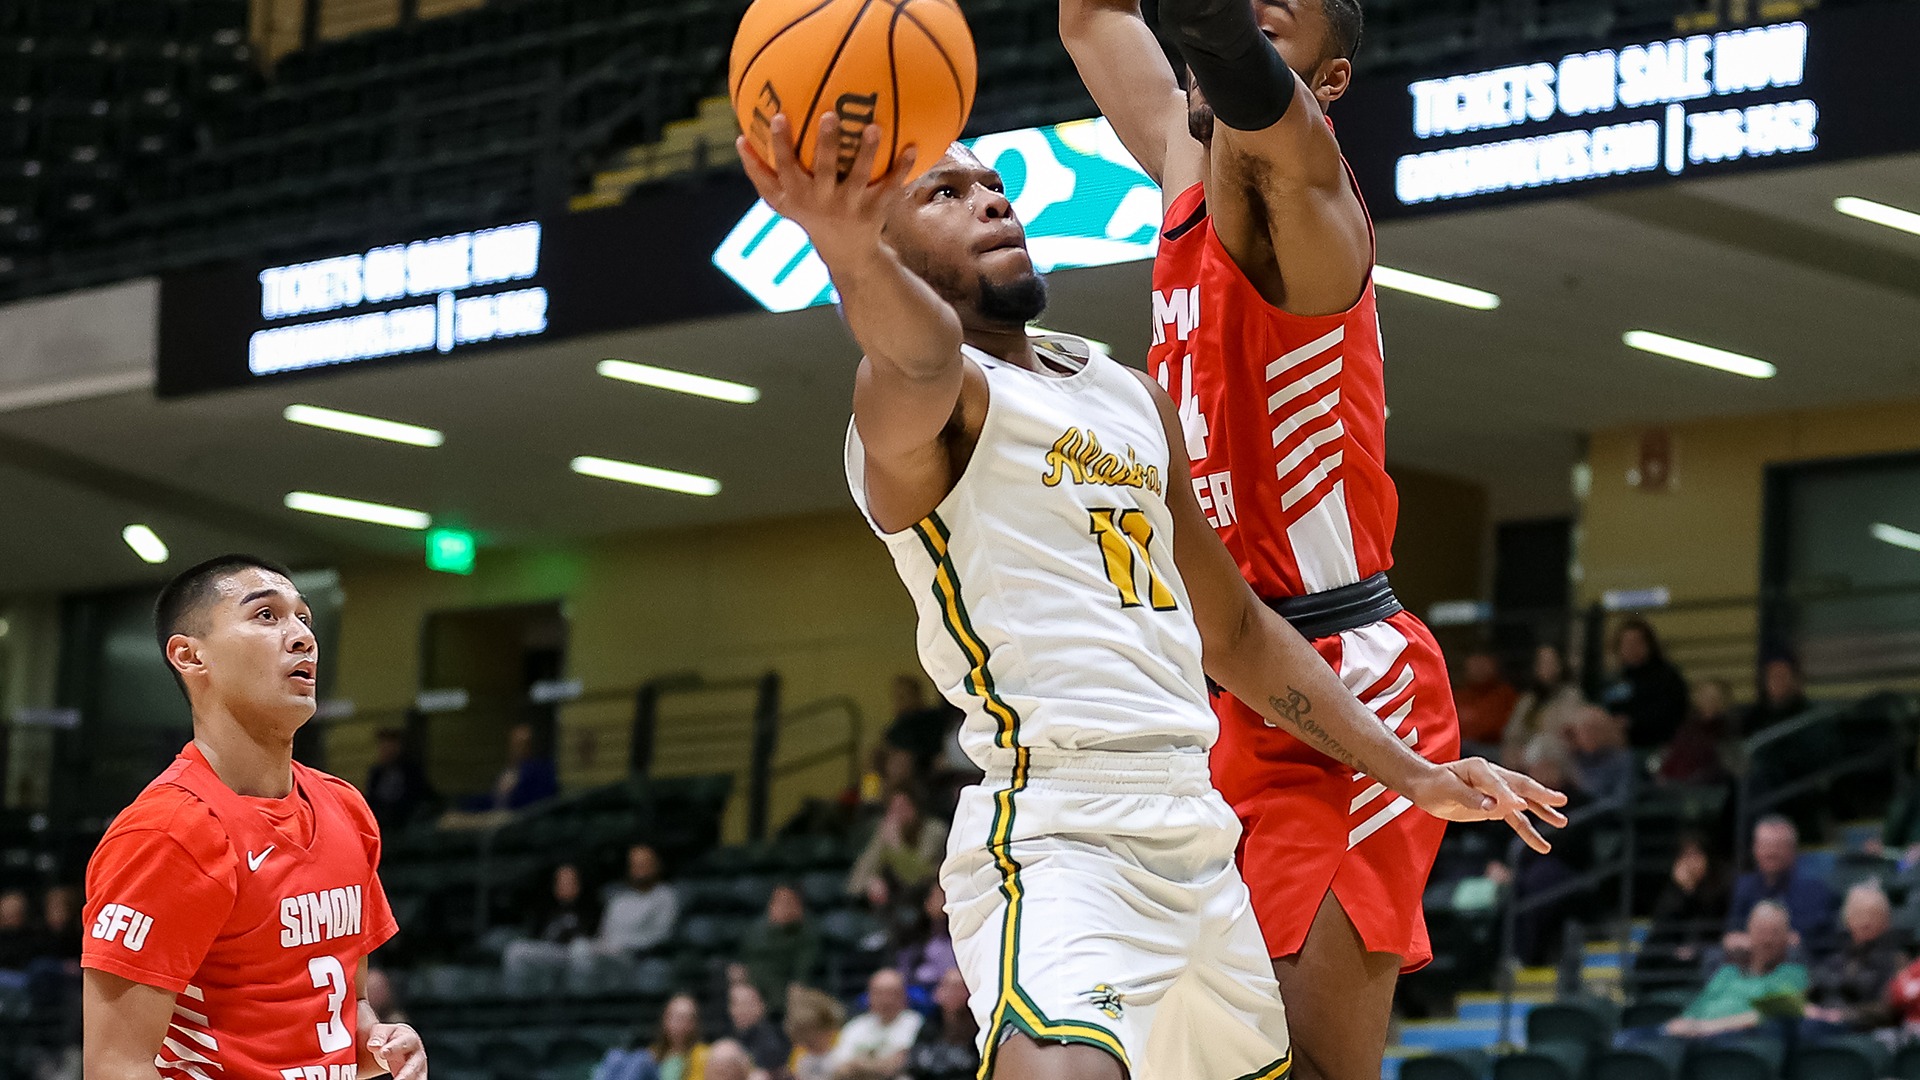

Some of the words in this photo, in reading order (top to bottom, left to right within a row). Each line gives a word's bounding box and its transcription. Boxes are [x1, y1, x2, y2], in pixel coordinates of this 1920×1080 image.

[1408, 62, 1556, 138] TICKETS
[1618, 34, 1712, 107] SALE
[1042, 426, 1162, 497] Alaska
[1086, 507, 1178, 611] 11
[91, 902, 154, 952] SFU
[280, 884, 362, 948] SIMON
[307, 955, 352, 1054] 3
